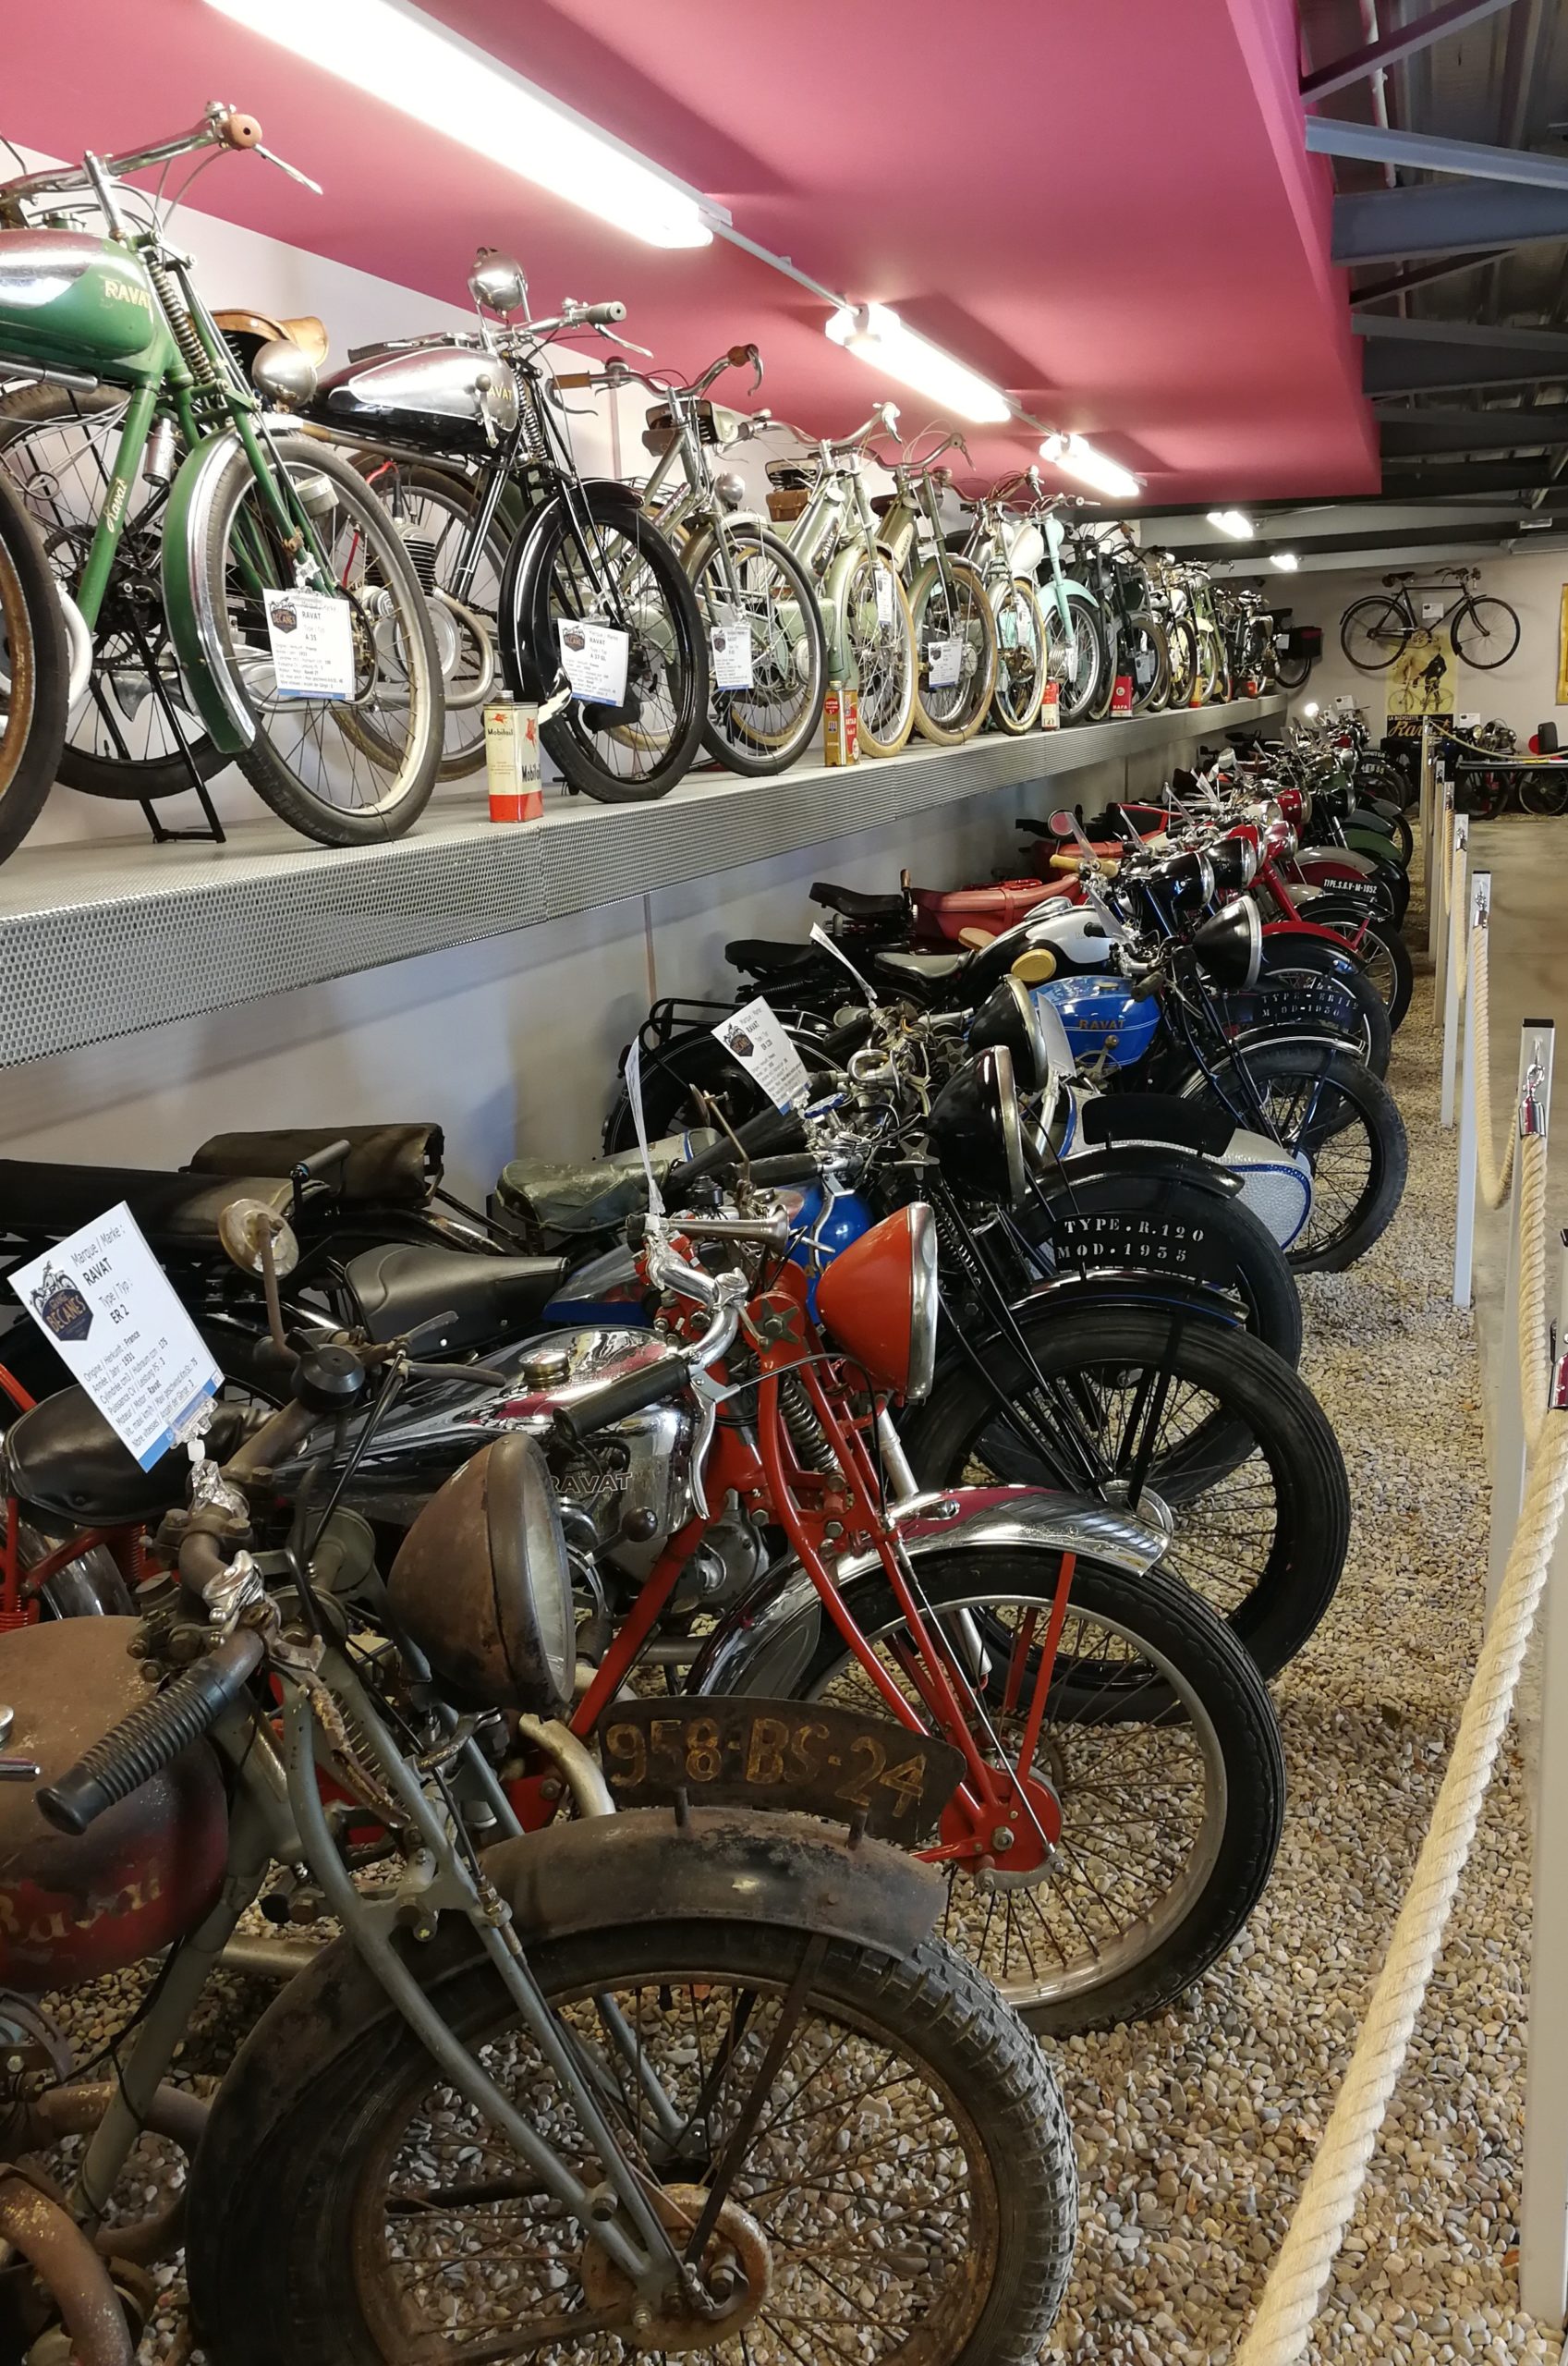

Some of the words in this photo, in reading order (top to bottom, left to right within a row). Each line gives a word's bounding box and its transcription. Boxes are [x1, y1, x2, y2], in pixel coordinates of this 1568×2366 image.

[104, 280, 152, 311] RAVA
[488, 386, 512, 400] AVAT
[301, 610, 322, 620] RAVAT
[1079, 1019, 1125, 1029] RAVAT
[70, 1243, 98, 1266] Marque
[100, 1227, 121, 1246] Marke
[82, 1257, 112, 1286] RAVAT
[98, 1292, 115, 1307] Type
[115, 1281, 129, 1294] Typ
[46, 1295, 85, 1332] BECANES
[110, 1309, 124, 1323] ER
[119, 1303, 129, 1316] 2
[123, 1330, 140, 1347] France
[158, 1336, 168, 1349] 175
[121, 1351, 135, 1366] 1931
[147, 1379, 162, 1395] Ravat
